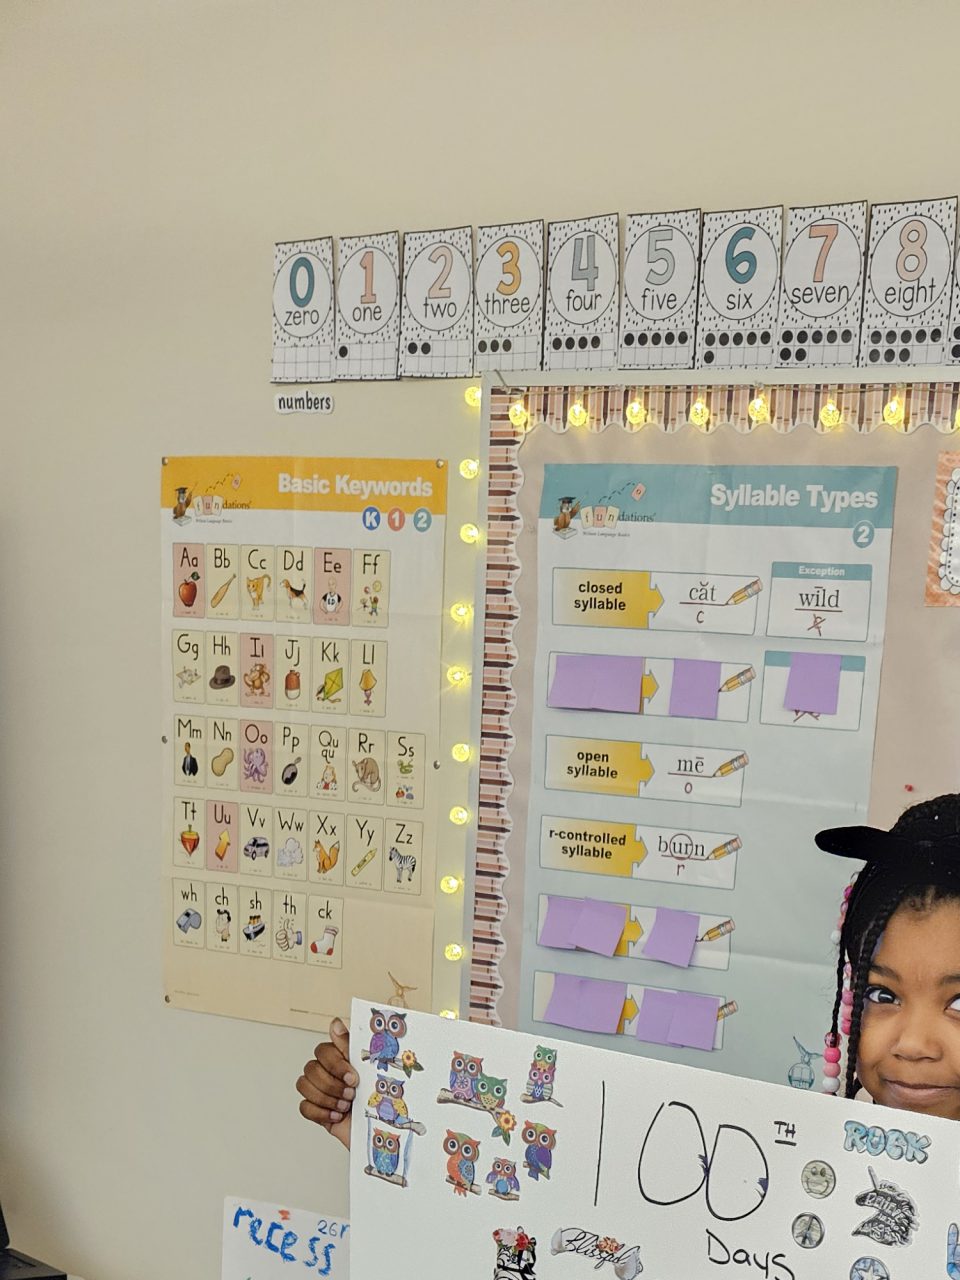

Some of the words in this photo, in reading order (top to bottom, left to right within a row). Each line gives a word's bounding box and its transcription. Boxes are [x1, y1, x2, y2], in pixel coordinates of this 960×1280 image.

[646, 230, 675, 285] 5
[725, 227, 757, 285] 6
[808, 224, 839, 282] 7
[896, 220, 927, 282] 8
[428, 245, 454, 298] 2
[496, 240, 521, 296] 3
[571, 235, 599, 292] 4
[289, 257, 314, 307] 0
[360, 251, 376, 304] 1
[566, 289, 601, 311] four
[641, 288, 677, 311] five
[726, 289, 753, 311] six
[791, 284, 849, 304] seven
[884, 280, 936, 310] eight
[284, 304, 320, 326] zero
[352, 305, 382, 321] one
[423, 298, 457, 318] two
[484, 295, 530, 316] three
[278, 393, 331, 413] numbers
[278, 473, 330, 494] Basic
[336, 475, 433, 500] Keywords
[711, 484, 800, 511] Syllable
[806, 485, 878, 516] Types
[365, 512, 378, 527] K
[180, 548, 198, 568] Aa
[214, 549, 230, 568] Bb
[248, 549, 266, 570] Cc
[284, 551, 304, 571] Dd
[324, 553, 341, 573] Ee
[363, 554, 380, 574] Ff
[799, 566, 845, 577] Exception
[579, 582, 622, 594] closed
[574, 598, 626, 611] syllable
[577, 751, 609, 763] open
[567, 765, 618, 779] syllable
[549, 828, 626, 846] r-controlled
[658, 836, 705, 858] burn
[562, 844, 612, 859] syllable
[181, 884, 197, 901] wh
[215, 887, 228, 906] ch
[250, 891, 262, 910] sh
[283, 895, 296, 915] th
[318, 901, 332, 919] ck
[594, 1080, 769, 1221] 100
[844, 1121, 931, 1164] ROCK
[233, 1206, 335, 1276] recess
